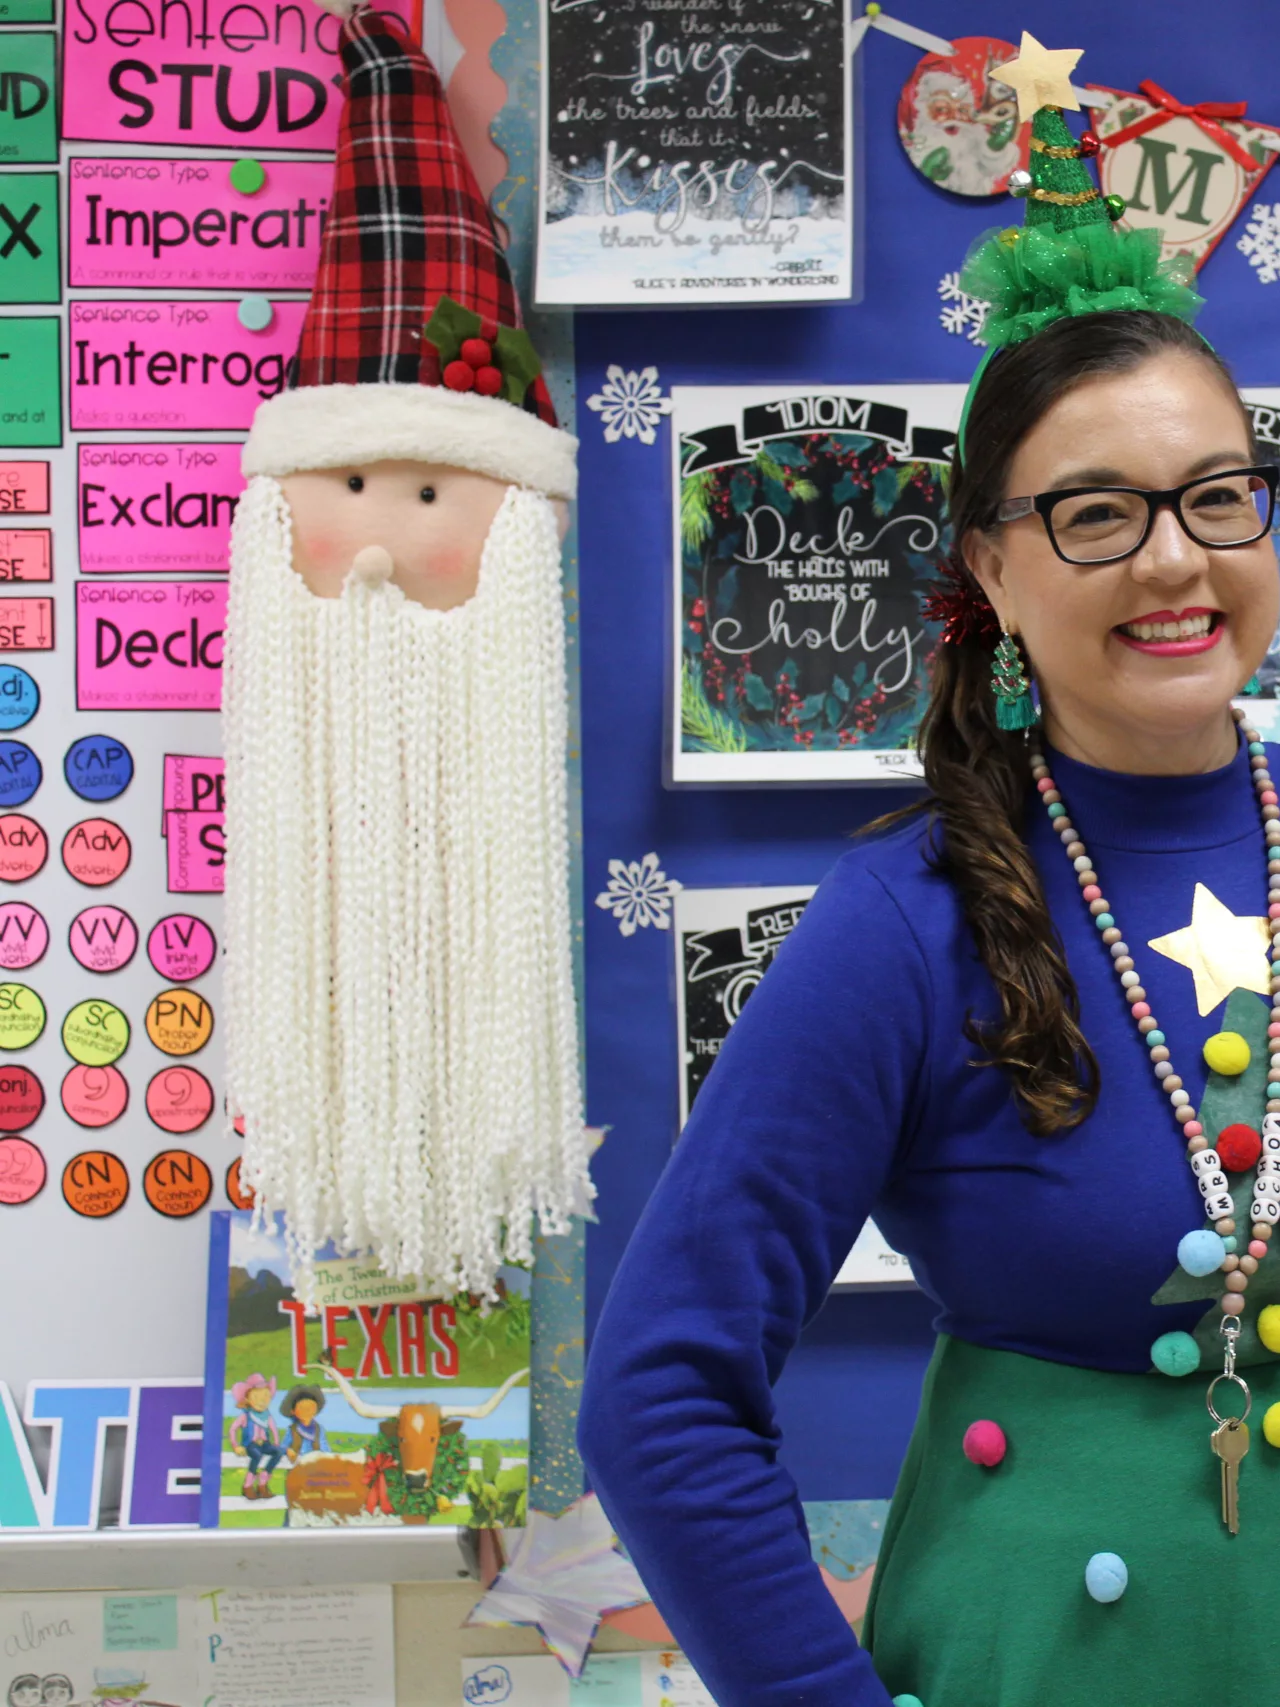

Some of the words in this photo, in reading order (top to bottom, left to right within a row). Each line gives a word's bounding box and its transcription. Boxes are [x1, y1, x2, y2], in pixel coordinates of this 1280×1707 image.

[74, 0, 338, 54] Sentenc
[681, 15, 714, 34] the
[720, 20, 783, 33] snow
[610, 21, 765, 104] Loves
[108, 59, 341, 133] STUD
[566, 97, 605, 121] the
[616, 99, 678, 119] trees
[686, 96, 738, 119] and
[660, 130, 702, 147] that
[709, 131, 730, 147] it
[580, 141, 810, 233] Kisses
[600, 226, 662, 248] them
[671, 234, 701, 247] so
[708, 224, 799, 255] gently?
[76, 341, 297, 399] Interrog
[766, 397, 872, 431] IDIOM
[733, 505, 920, 564] Deck
[766, 560, 793, 578] THE
[799, 558, 846, 577] HALLS
[850, 560, 890, 577] WITH
[784, 583, 845, 602] BOUGHS
[850, 583, 872, 601] OF
[73, 748, 123, 770] CAP
[71, 828, 123, 851] Adv
[78, 916, 125, 944] VV
[163, 921, 195, 949] LV
[154, 1000, 203, 1027] PN
[71, 1157, 110, 1188] CN
[154, 1157, 193, 1187] CN
[315, 1269, 343, 1286] The
[322, 1286, 339, 1304] of
[342, 1280, 418, 1301] Christmas
[278, 1299, 460, 1380] TEXAS
